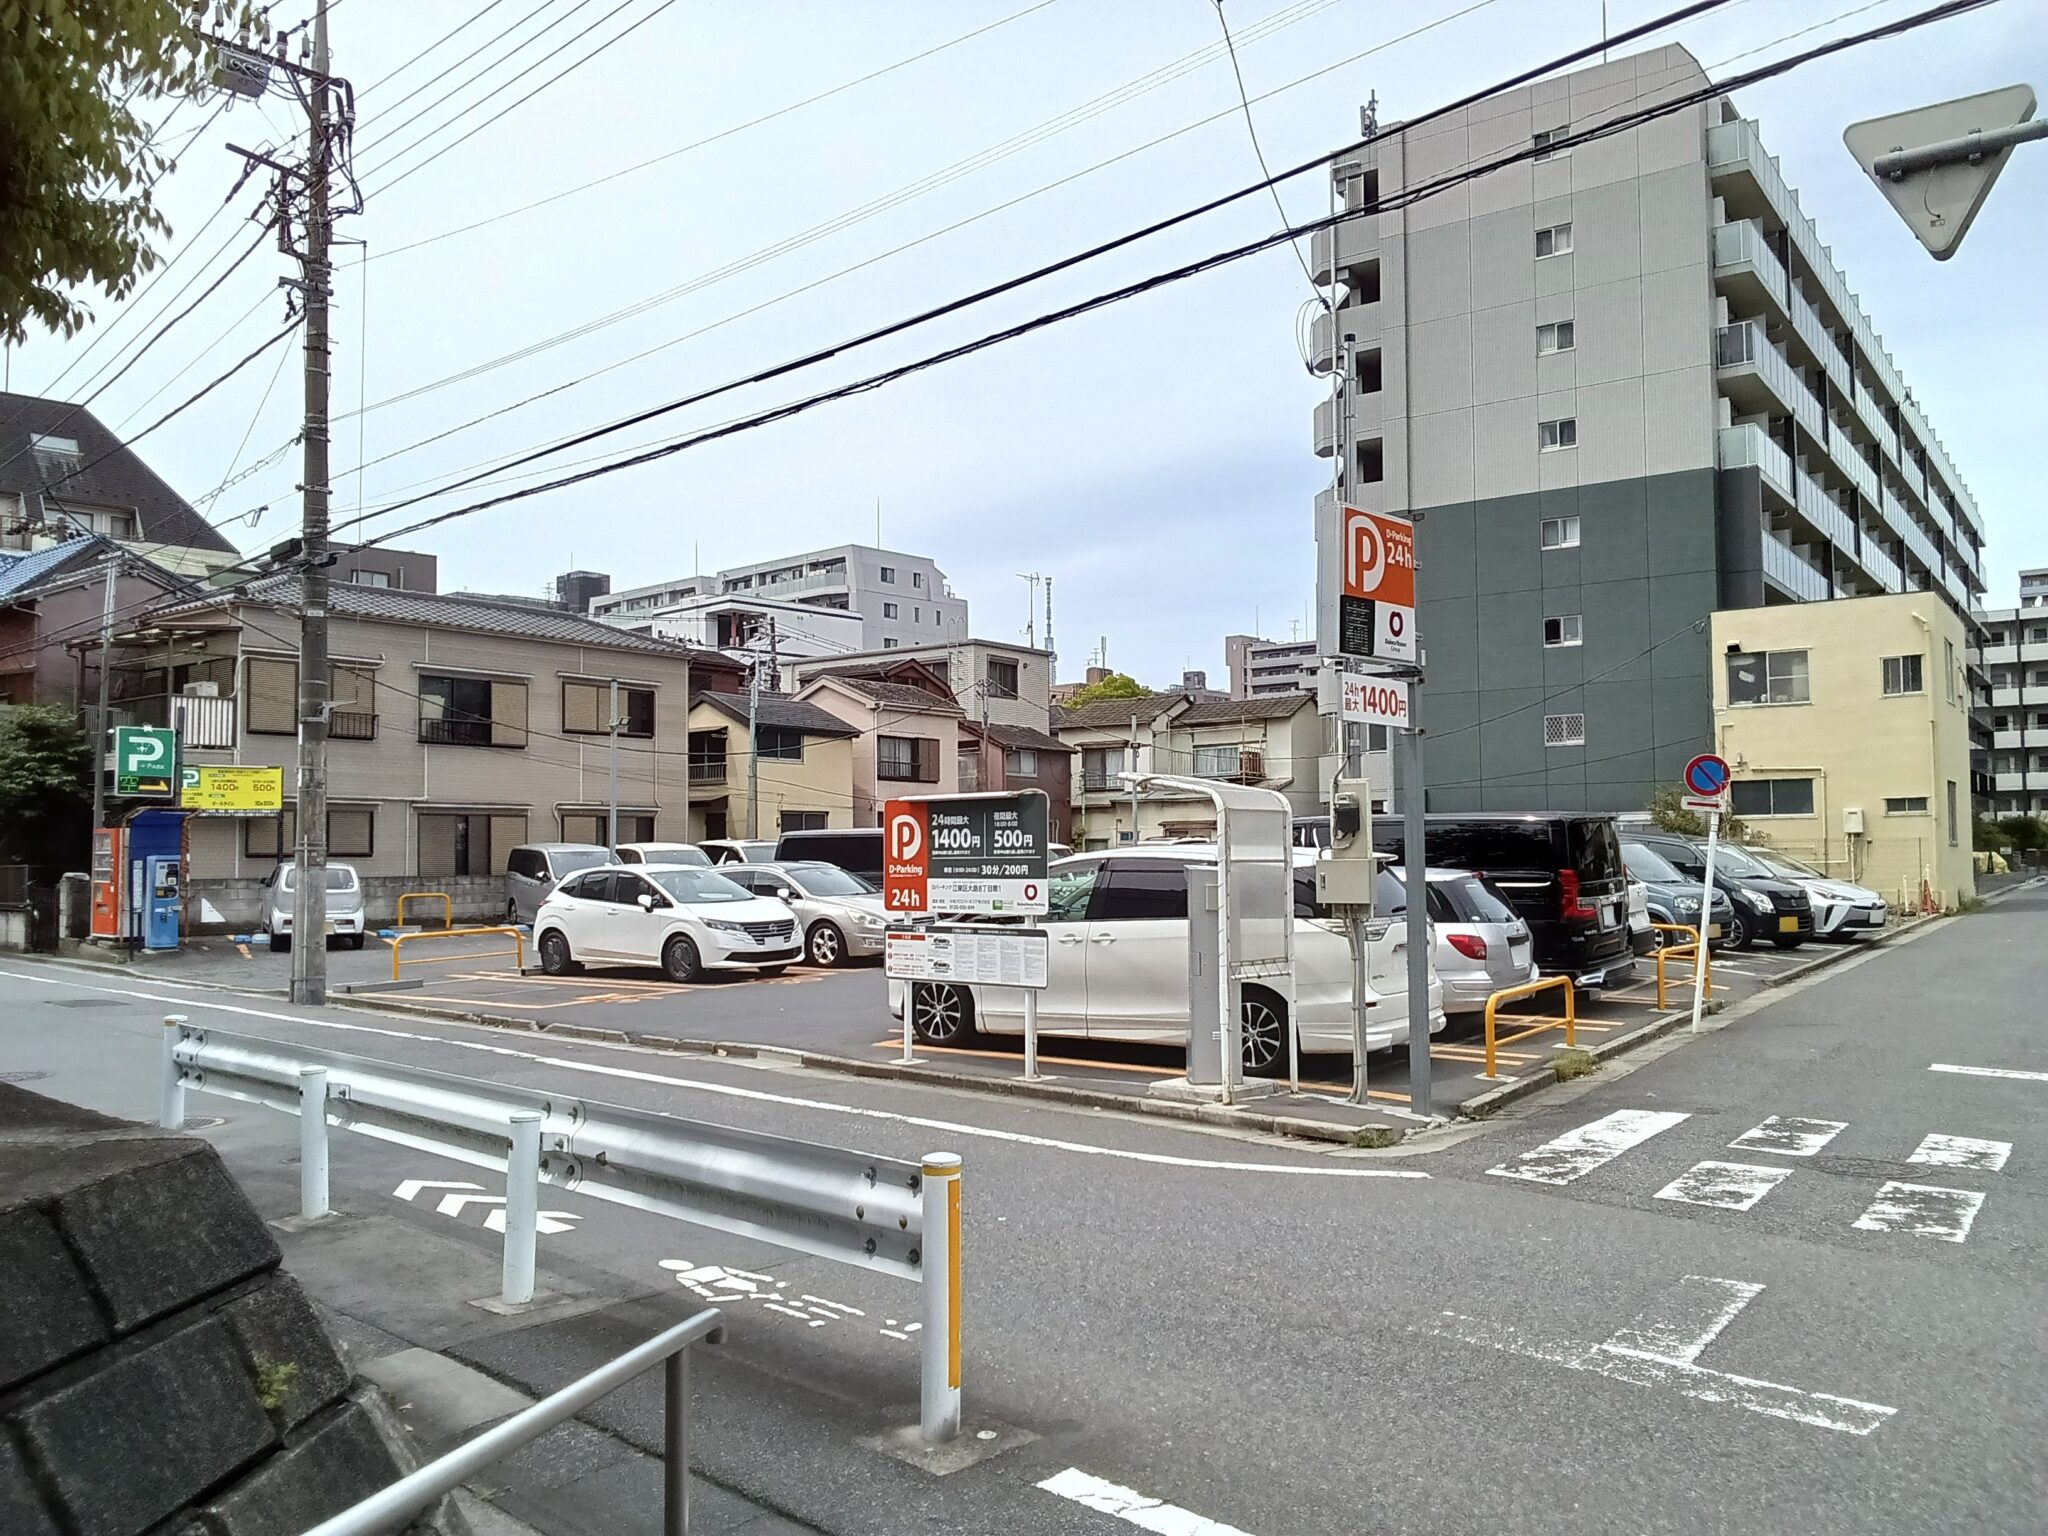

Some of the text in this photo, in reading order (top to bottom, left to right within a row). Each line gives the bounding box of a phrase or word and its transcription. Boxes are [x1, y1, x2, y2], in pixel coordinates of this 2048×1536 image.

[1385, 529, 1412, 547] D-Parking
[1387, 541, 1412, 569] 24h
[1344, 681, 1360, 697] 24h
[1344, 698, 1360, 712] 最大
[1360, 685, 1407, 718] 1400円
[129, 736, 164, 771] P
[931, 814, 969, 826] 24時間最大
[931, 828, 980, 848] 1400円
[993, 829, 1033, 848] 500円
[888, 864, 923, 876] D-Parking
[981, 864, 1029, 876] 30分/200円
[891, 889, 920, 907] 24h
